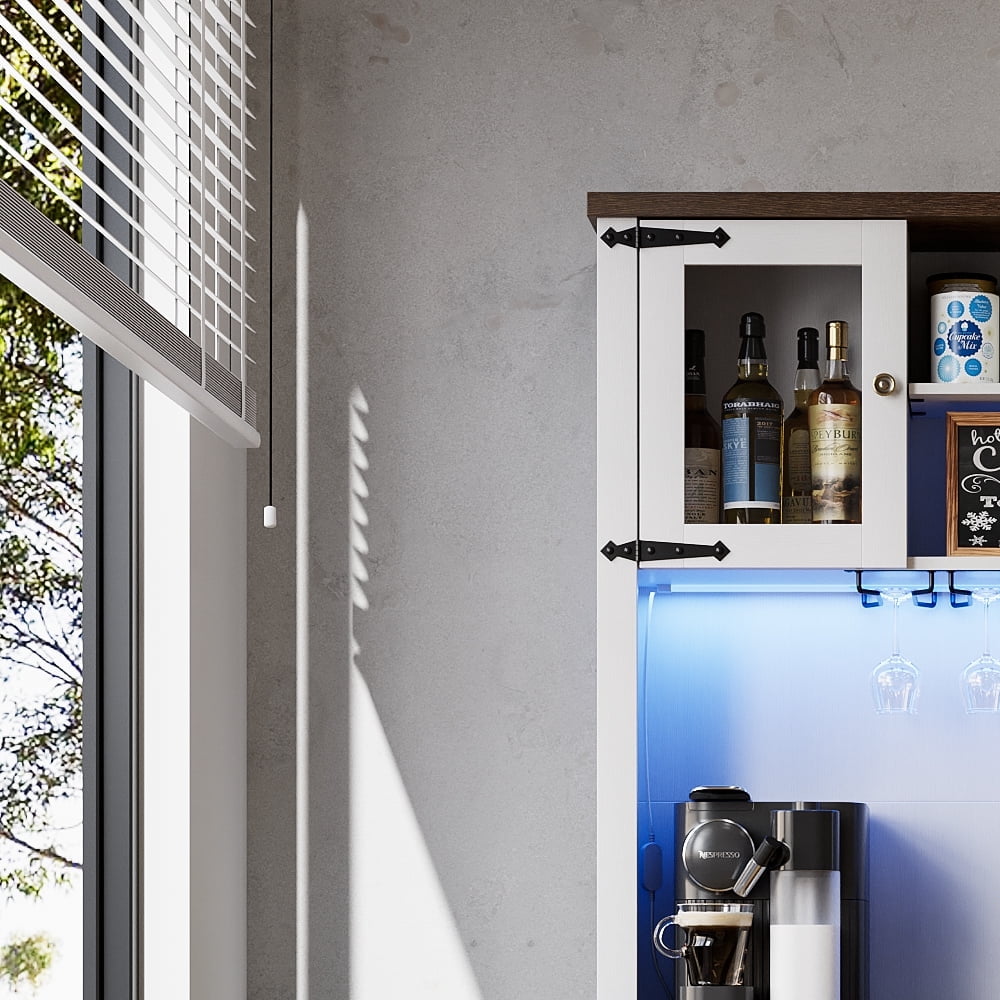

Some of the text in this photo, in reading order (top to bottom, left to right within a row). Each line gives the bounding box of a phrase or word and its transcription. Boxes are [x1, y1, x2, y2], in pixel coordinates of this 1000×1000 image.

[948, 331, 982, 343] Cupcake
[960, 341, 978, 350] Mix
[723, 401, 780, 410] TORABHAIG
[812, 429, 860, 440] PEYBUR
[698, 850, 740, 860] NESPRESSO
